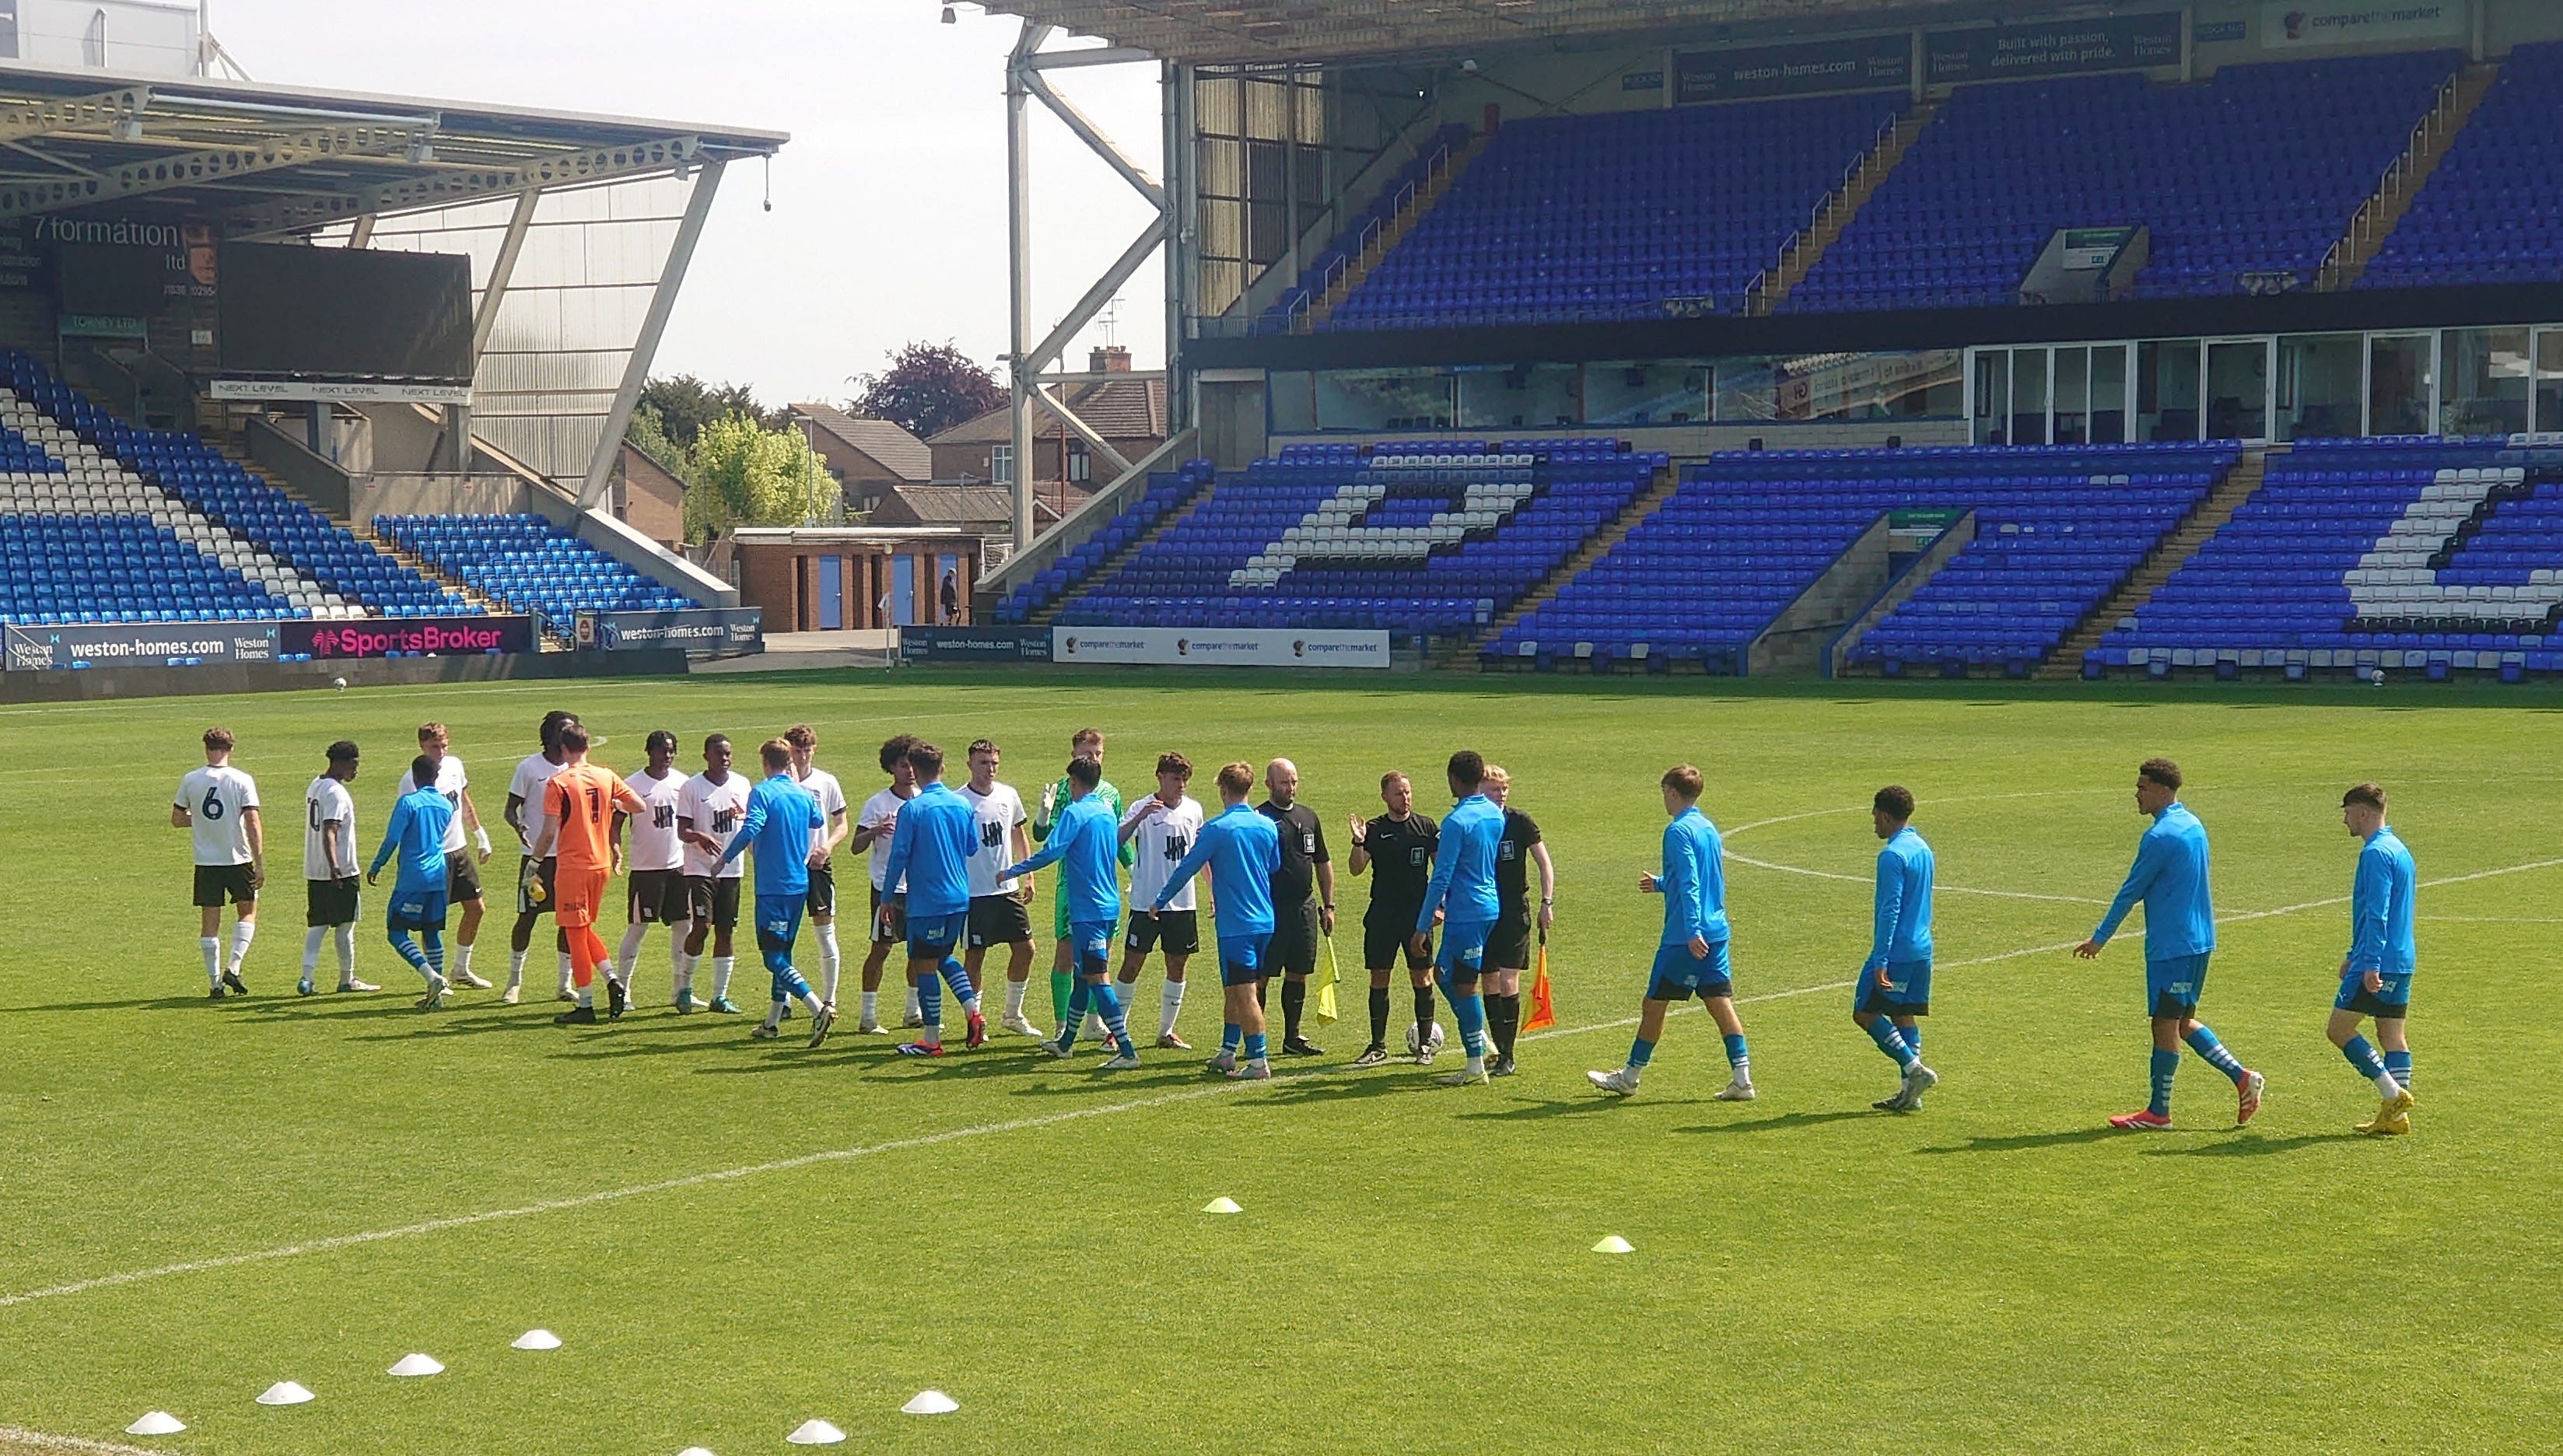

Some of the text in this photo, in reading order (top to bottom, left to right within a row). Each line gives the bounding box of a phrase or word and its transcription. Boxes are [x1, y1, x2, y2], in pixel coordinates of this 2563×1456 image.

[1998, 30, 2109, 51] Built with passion,
[1991, 45, 2116, 68] delivered with pride.
[1733, 60, 1856, 81] weston-homes.com
[166, 254, 186, 271] ltd
[253, 384, 289, 393] LEVEL
[433, 388, 466, 397] LEVEL
[621, 625, 723, 642] weston-homes.com
[730, 623, 755, 632] Weston
[234, 637, 269, 649] Weston
[341, 625, 502, 657] SportsBroker
[730, 632, 755, 642] Homes
[936, 638, 1014, 650] weston-homes.com
[1020, 638, 1047, 647] Weston
[70, 638, 224, 658] weston-homes.com
[235, 649, 269, 660] Homes
[1021, 647, 1047, 656] Homes
[202, 786, 224, 821] 6
[585, 787, 599, 824] 1
